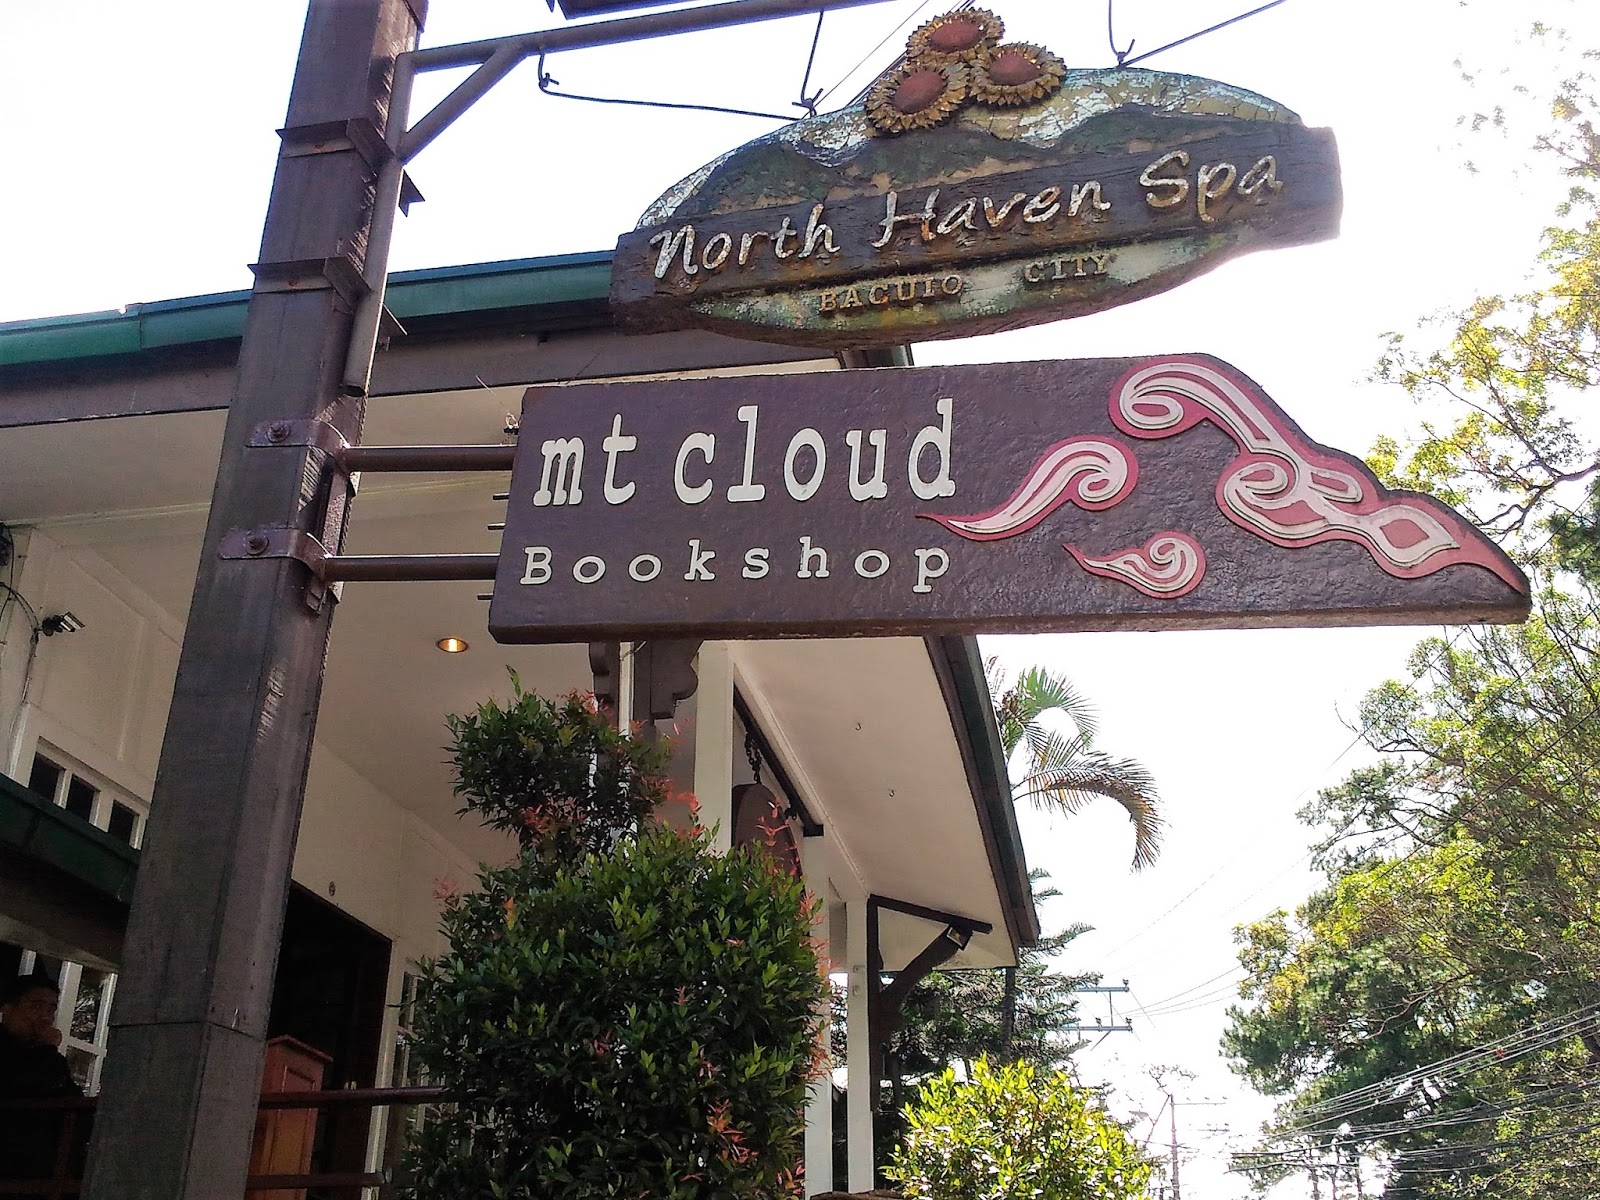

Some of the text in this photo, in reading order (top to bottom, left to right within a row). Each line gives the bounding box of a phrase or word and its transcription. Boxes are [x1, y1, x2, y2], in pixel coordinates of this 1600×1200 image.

[871, 179, 1111, 250] Haven
[1138, 150, 1283, 223] Spa
[1023, 254, 1110, 284] CITY
[532, 398, 956, 507] mt cloud
[519, 536, 951, 594] Bookshop
